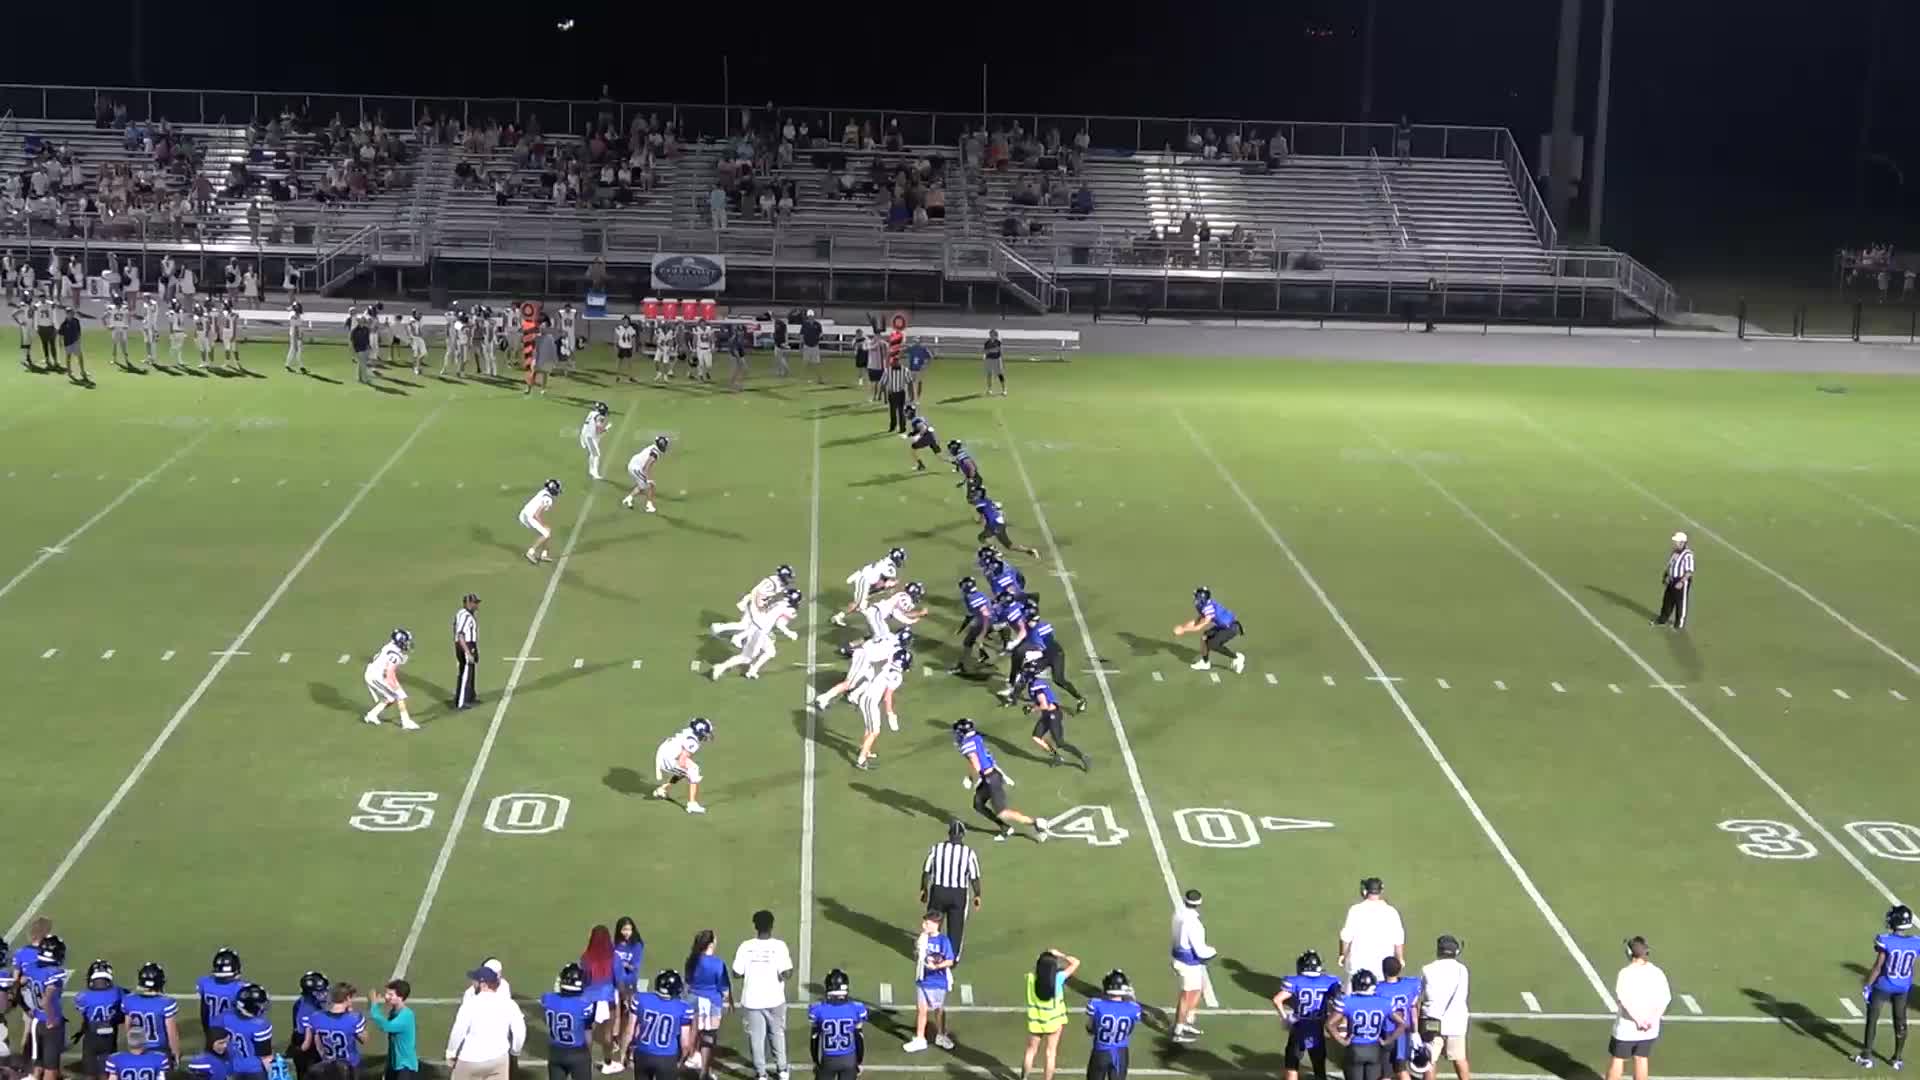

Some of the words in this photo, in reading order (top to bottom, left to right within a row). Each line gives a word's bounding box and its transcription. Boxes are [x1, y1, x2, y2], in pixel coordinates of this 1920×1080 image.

[1889, 949, 1916, 979] 10
[546, 1011, 575, 1045] 12
[642, 1011, 672, 1048] 70
[821, 1018, 855, 1050] 25
[1096, 1014, 1131, 1045] 28
[1351, 1008, 1384, 1041] 29
